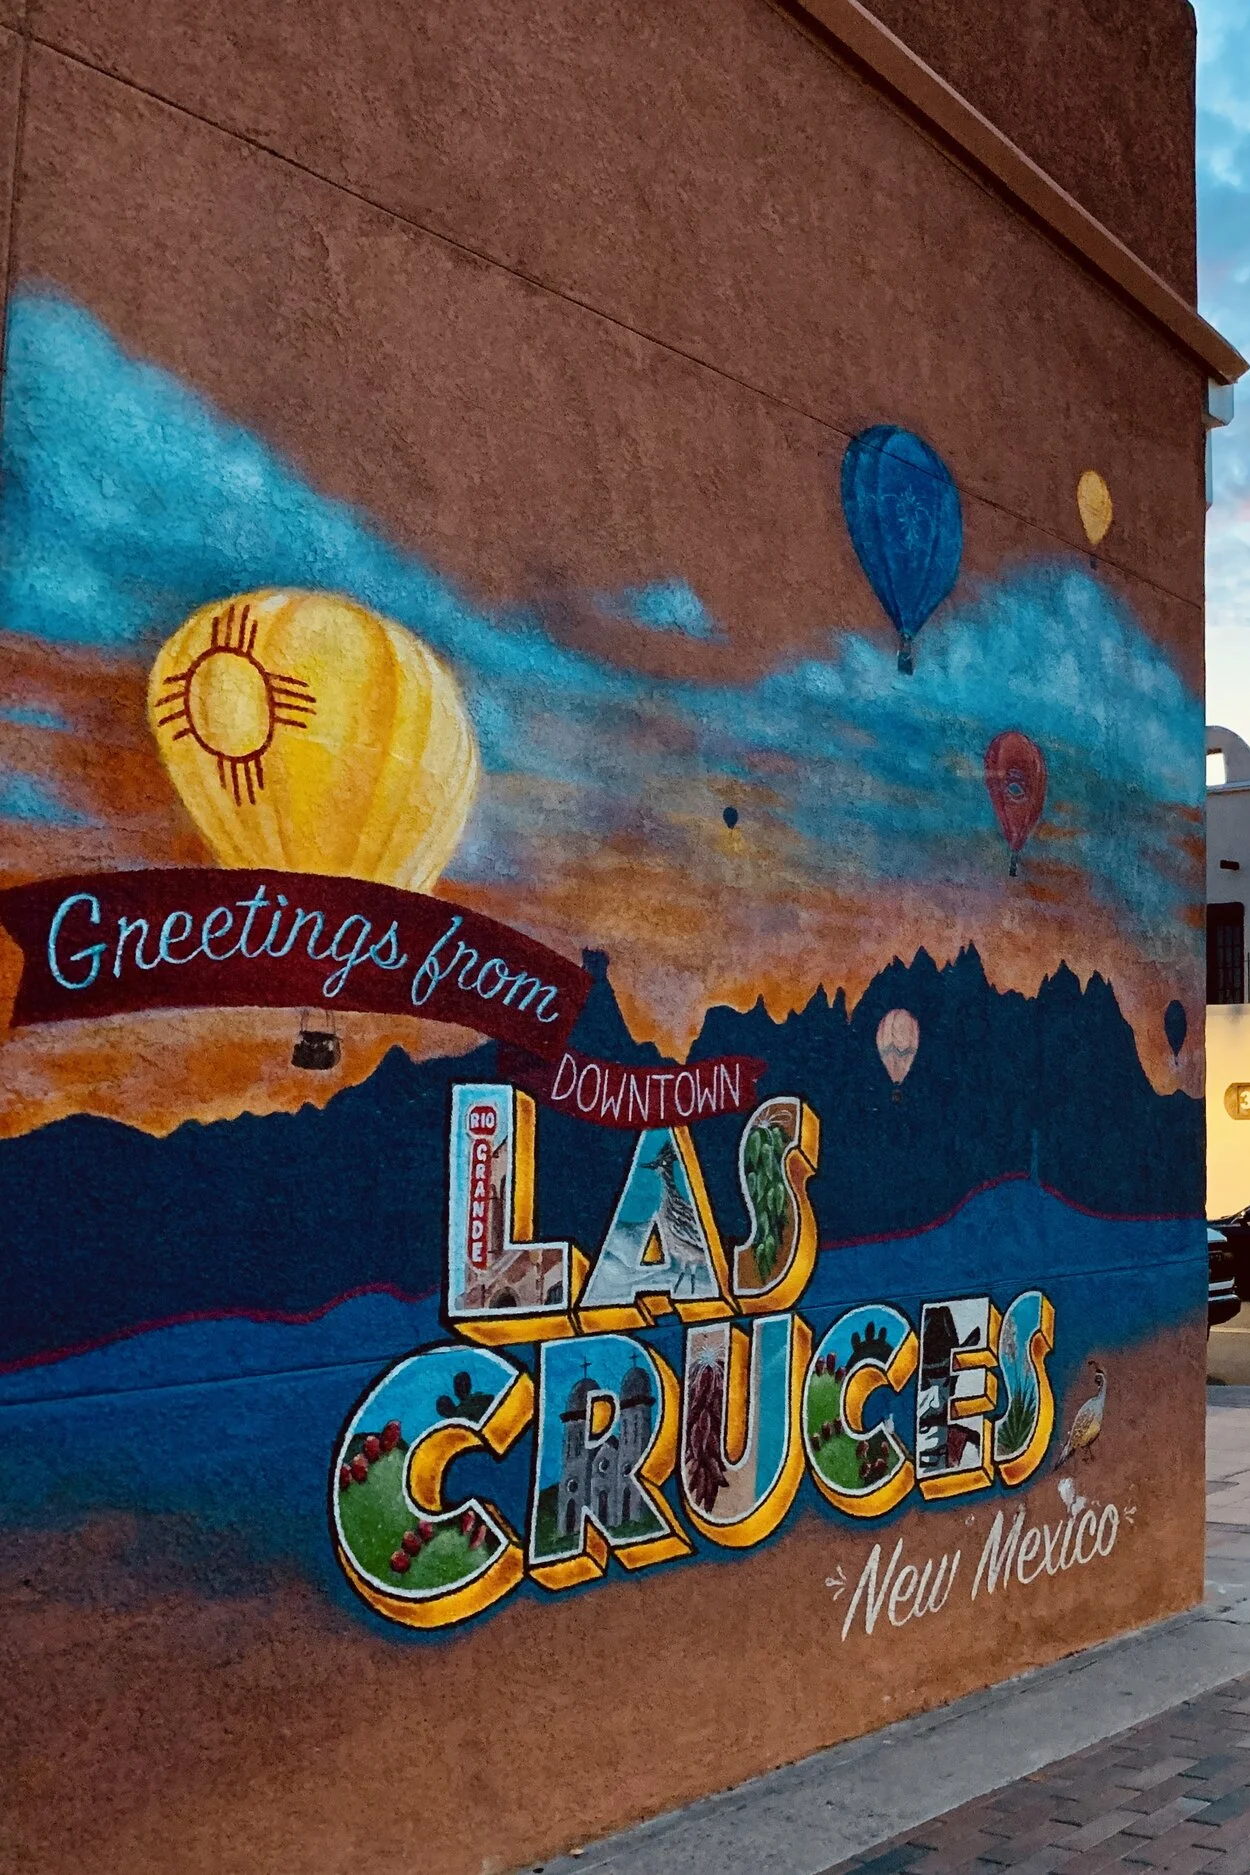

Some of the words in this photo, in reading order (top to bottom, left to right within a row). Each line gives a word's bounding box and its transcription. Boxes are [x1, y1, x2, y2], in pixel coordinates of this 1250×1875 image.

[48, 884, 408, 998] Greetings
[411, 916, 560, 1024] from
[470, 1112, 496, 1129] RIO
[550, 1052, 740, 1122] DOWNTOWN
[447, 1083, 820, 1340] LAS
[471, 1142, 488, 1263] GRANDE
[331, 1289, 1056, 1629] CRUCES
[841, 1537, 961, 1643] New
[971, 1503, 1120, 1602] Mexico
